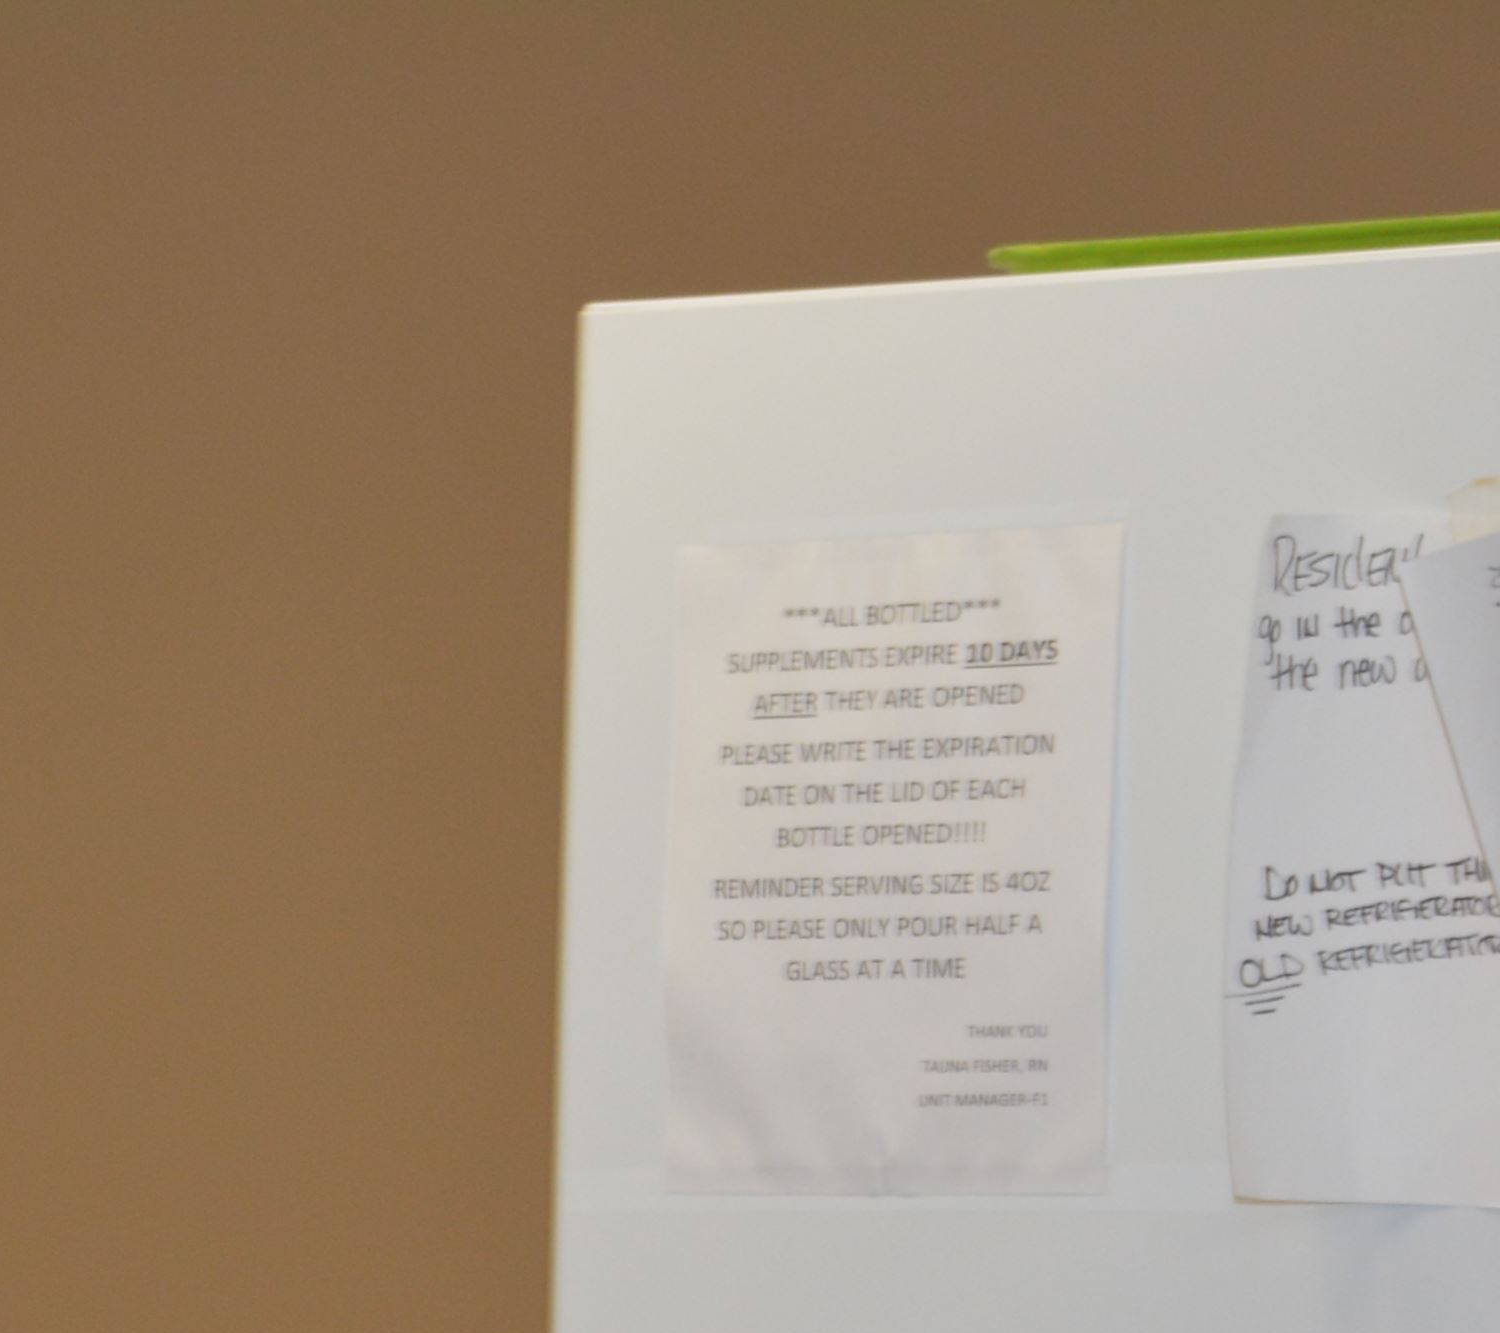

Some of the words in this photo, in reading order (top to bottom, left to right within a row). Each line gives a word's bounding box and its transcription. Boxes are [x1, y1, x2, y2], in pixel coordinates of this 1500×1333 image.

[727, 647, 879, 674] SUPPLEMENTS
[885, 643, 958, 669] EXPIRE
[965, 641, 993, 669] 10
[999, 639, 1059, 666] DAYS
[753, 693, 817, 719] AFTER
[826, 689, 877, 713] THEY
[884, 686, 925, 710] ARE
[932, 683, 1025, 708] OPENED
[721, 742, 793, 766] PLEASE
[800, 739, 867, 763] WRITE
[873, 737, 915, 761] THE
[923, 733, 1055, 760] EXPIRATION
[743, 784, 796, 807] DATE
[804, 783, 836, 806] ON
[842, 782, 884, 804] THE
[890, 780, 925, 802] LID
[932, 779, 960, 801] OF
[968, 777, 1026, 800] EACH
[776, 824, 855, 849] BOTTLE
[862, 821, 987, 846] OPENED!!!!
[713, 876, 825, 900] REMINDER
[831, 874, 924, 898] SERVING
[930, 873, 974, 895] SIZE
[981, 872, 1000, 894] IS
[717, 920, 746, 942] SO
[752, 917, 826, 941] PLEASE
[833, 916, 890, 940] ONLY
[898, 914, 958, 938] POUR
[965, 913, 1020, 936] HALF
[1026, 913, 1044, 936] A
[786, 959, 850, 982] GLASS
[856, 958, 884, 980] AT
[890, 957, 907, 979] A
[912, 956, 967, 980] TIME
[1239, 953, 1305, 988] OLD
[966, 1024, 1014, 1039] THANK
[1018, 1024, 1049, 1039] YOU
